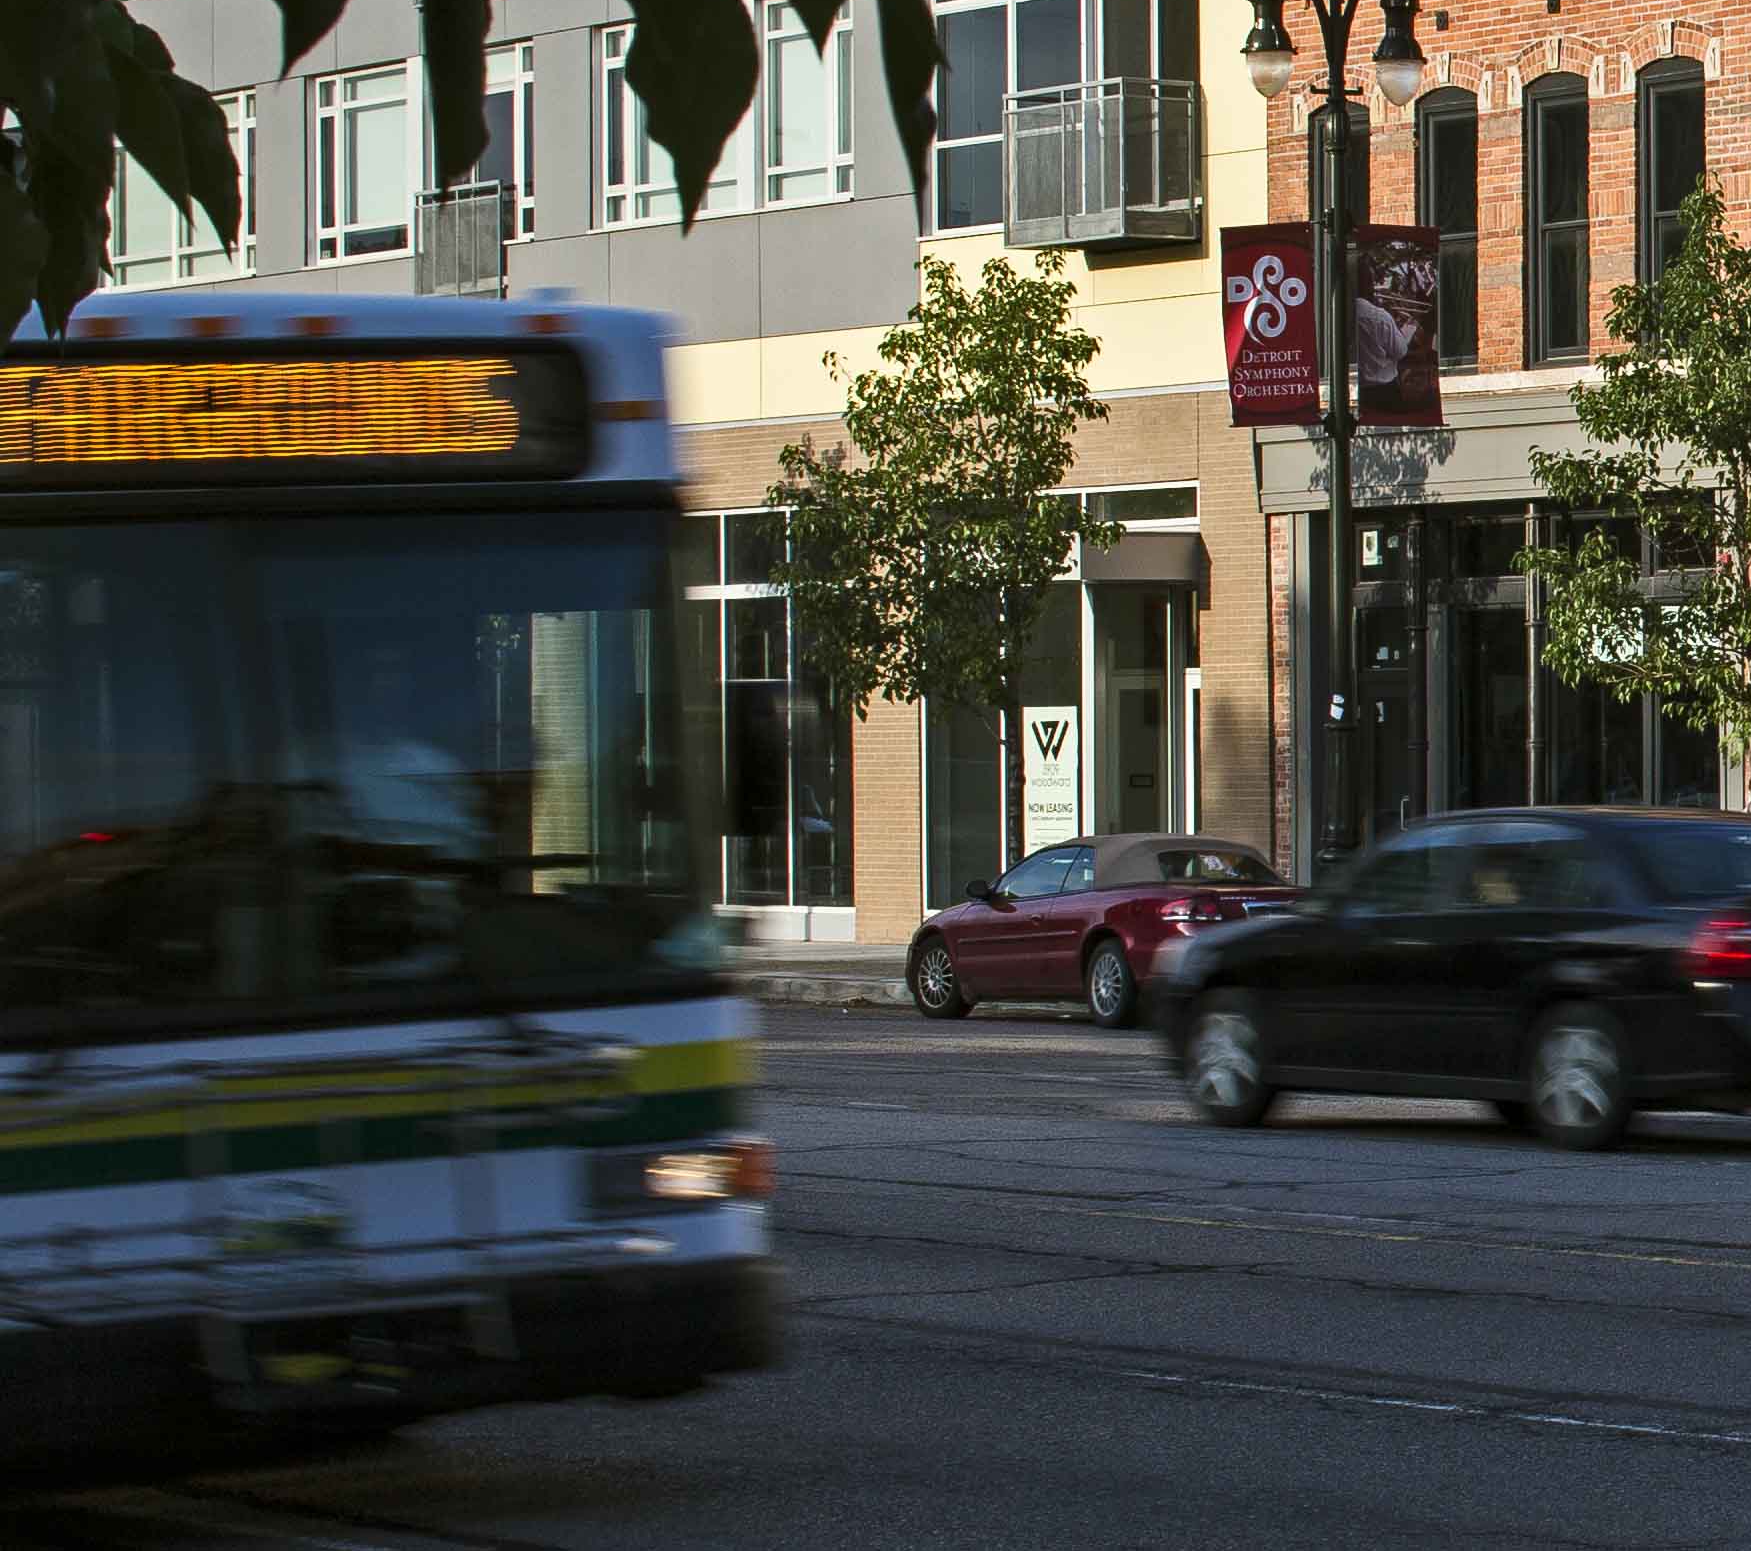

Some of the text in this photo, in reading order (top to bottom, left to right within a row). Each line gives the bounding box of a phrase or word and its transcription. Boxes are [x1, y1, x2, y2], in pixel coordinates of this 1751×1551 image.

[1227, 255, 1307, 346] DSO
[1242, 350, 1303, 364] DETROIT
[1234, 366, 1311, 381] SYMPHONY
[1233, 383, 1314, 398] ORCHESTRA
